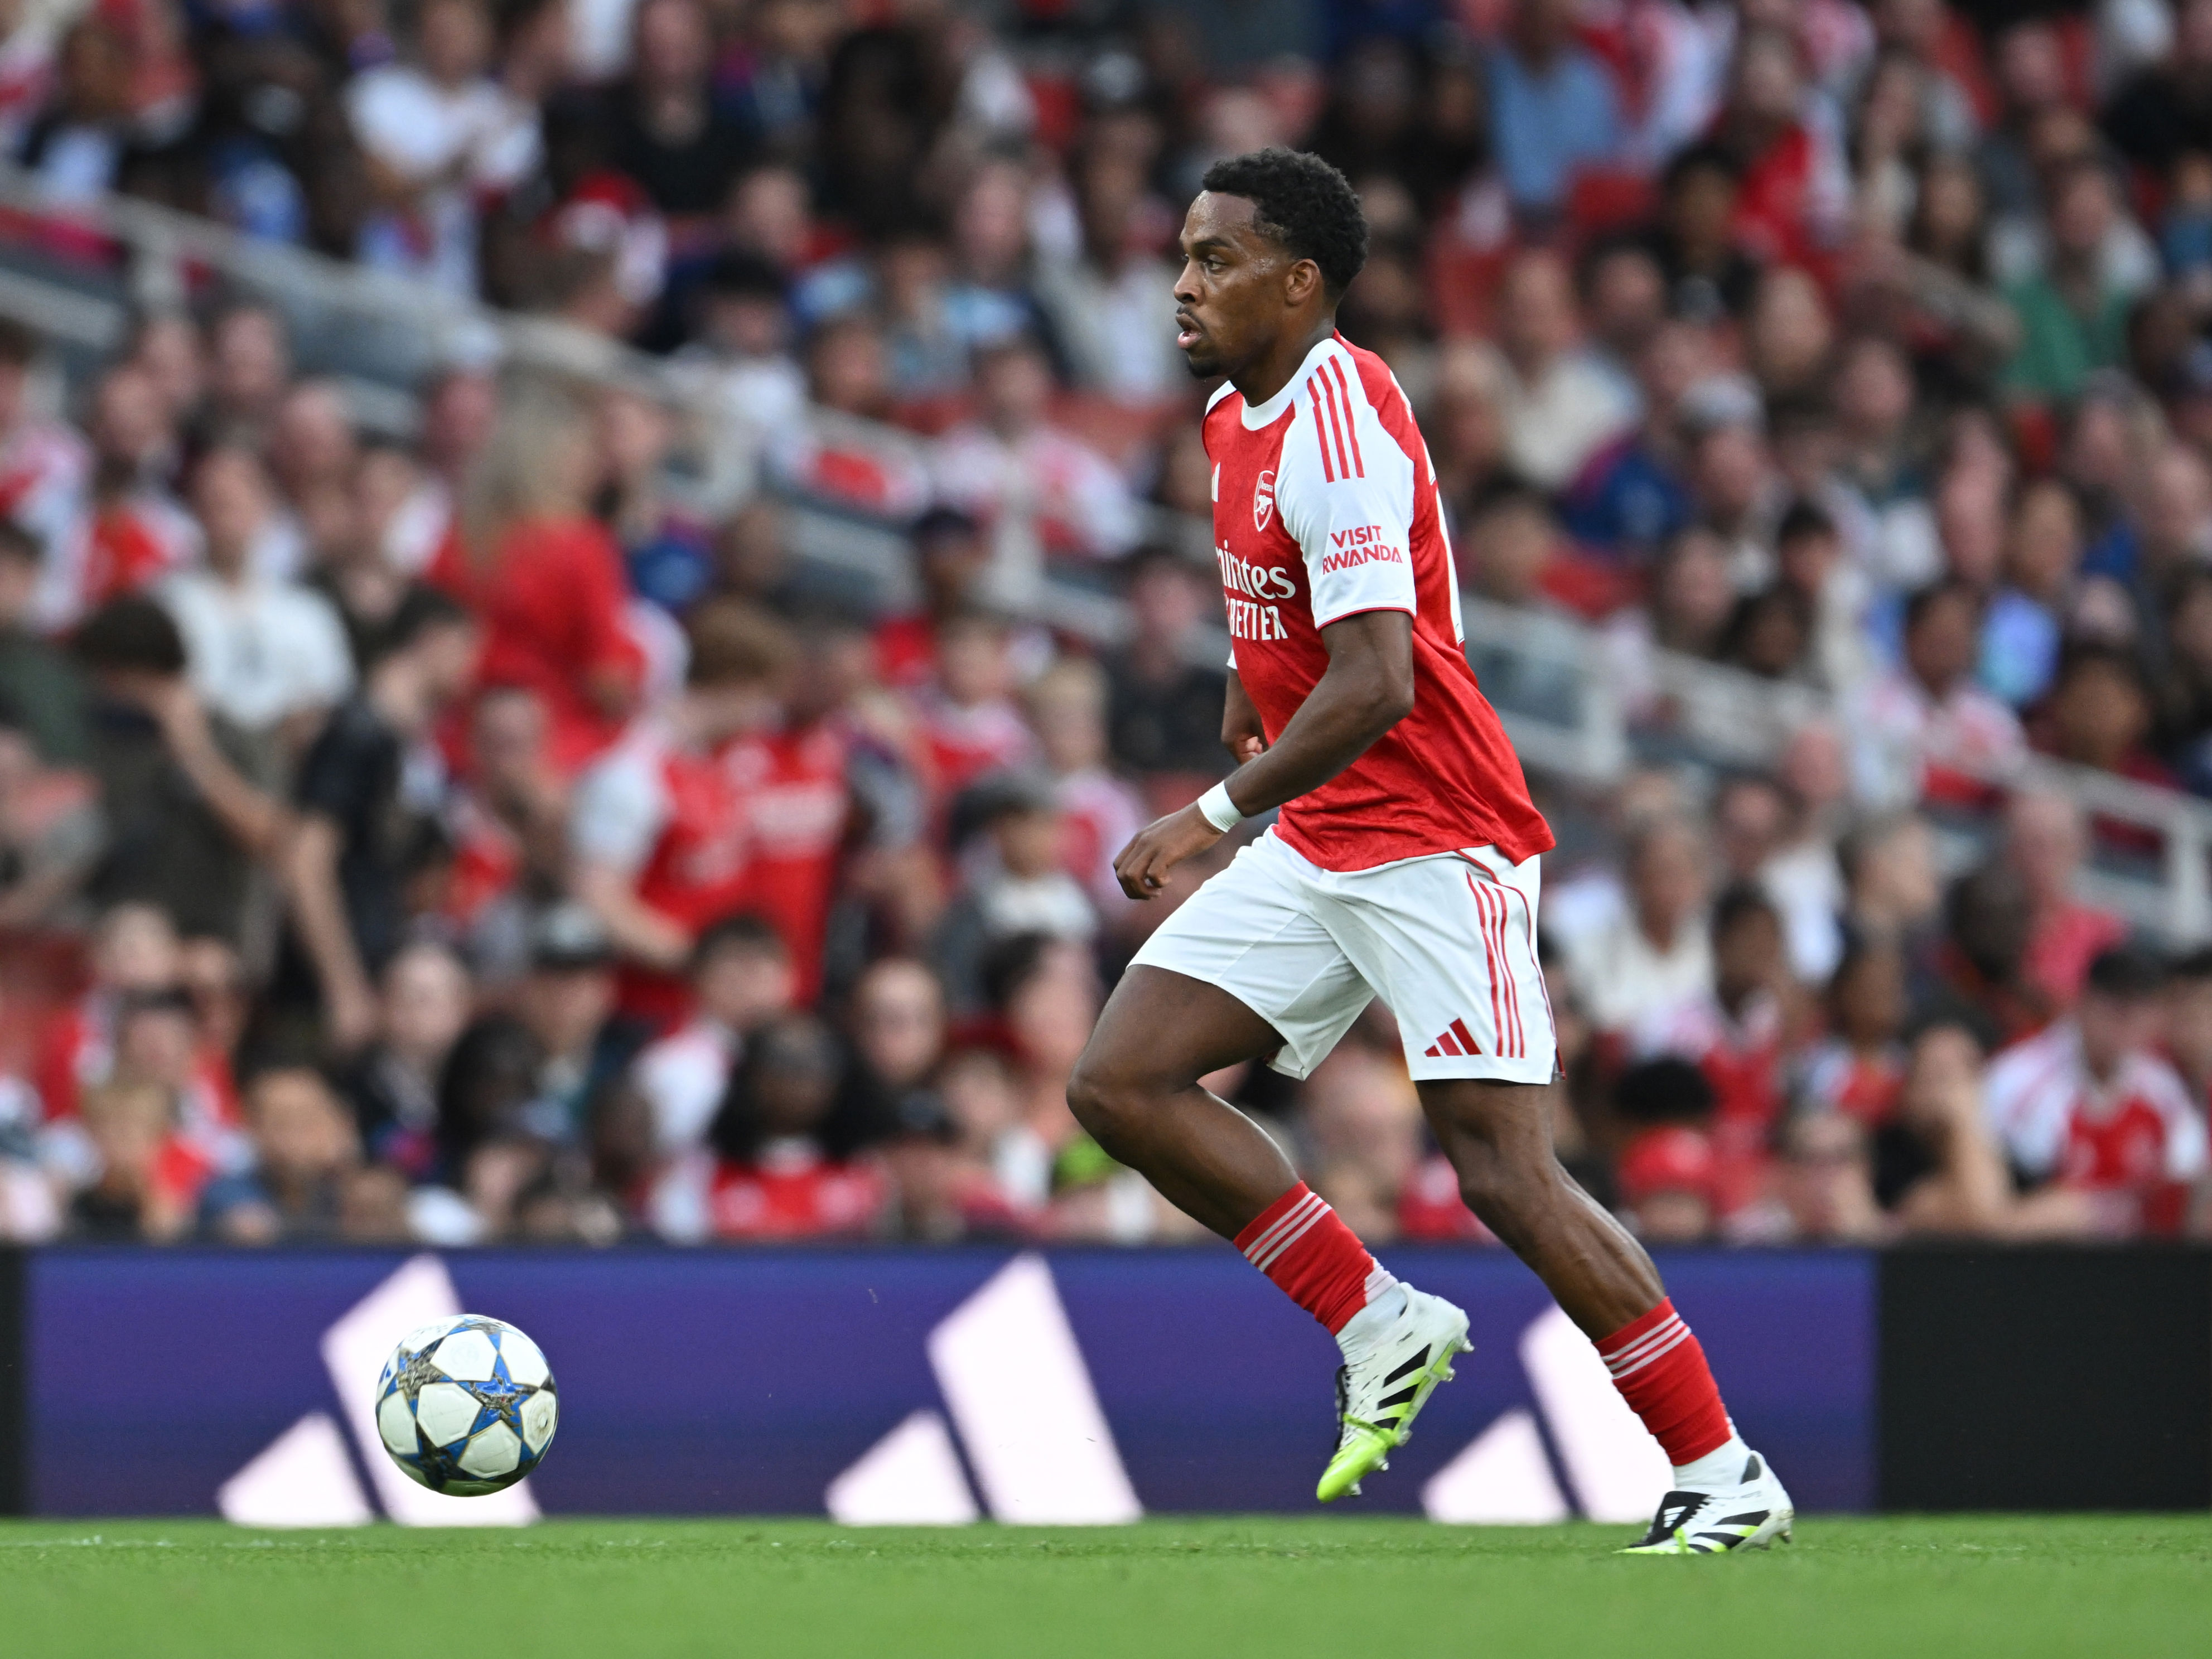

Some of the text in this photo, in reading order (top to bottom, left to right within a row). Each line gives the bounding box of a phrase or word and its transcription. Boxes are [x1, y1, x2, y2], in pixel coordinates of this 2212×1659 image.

[1330, 525, 1382, 548] VISIT
[1322, 544, 1403, 575] RWANDA
[1230, 598, 1288, 640] BETTER
